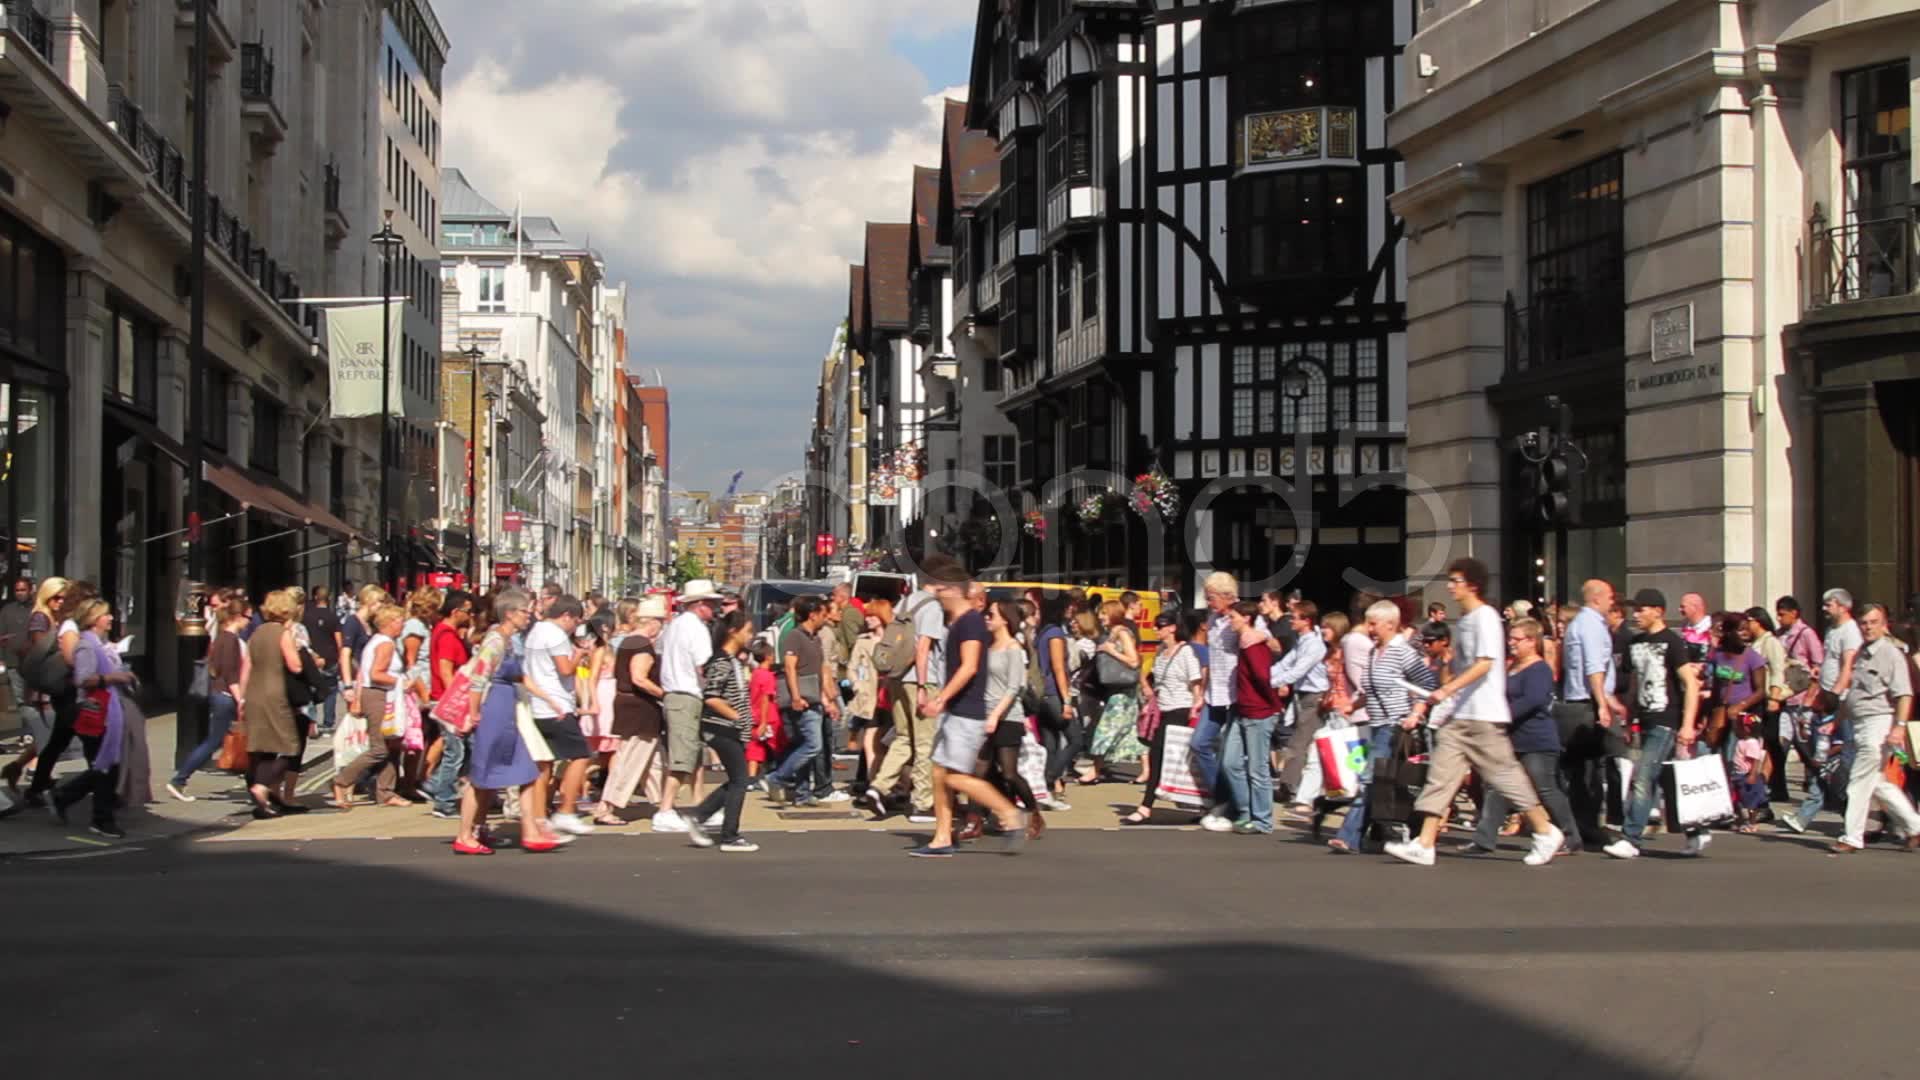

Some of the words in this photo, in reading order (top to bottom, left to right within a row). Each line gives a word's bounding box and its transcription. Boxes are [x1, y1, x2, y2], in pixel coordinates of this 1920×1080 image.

[340, 357, 385, 369] BANAN
[337, 370, 394, 381] REPUBLC
[1203, 448, 1379, 474] LIBERTY
